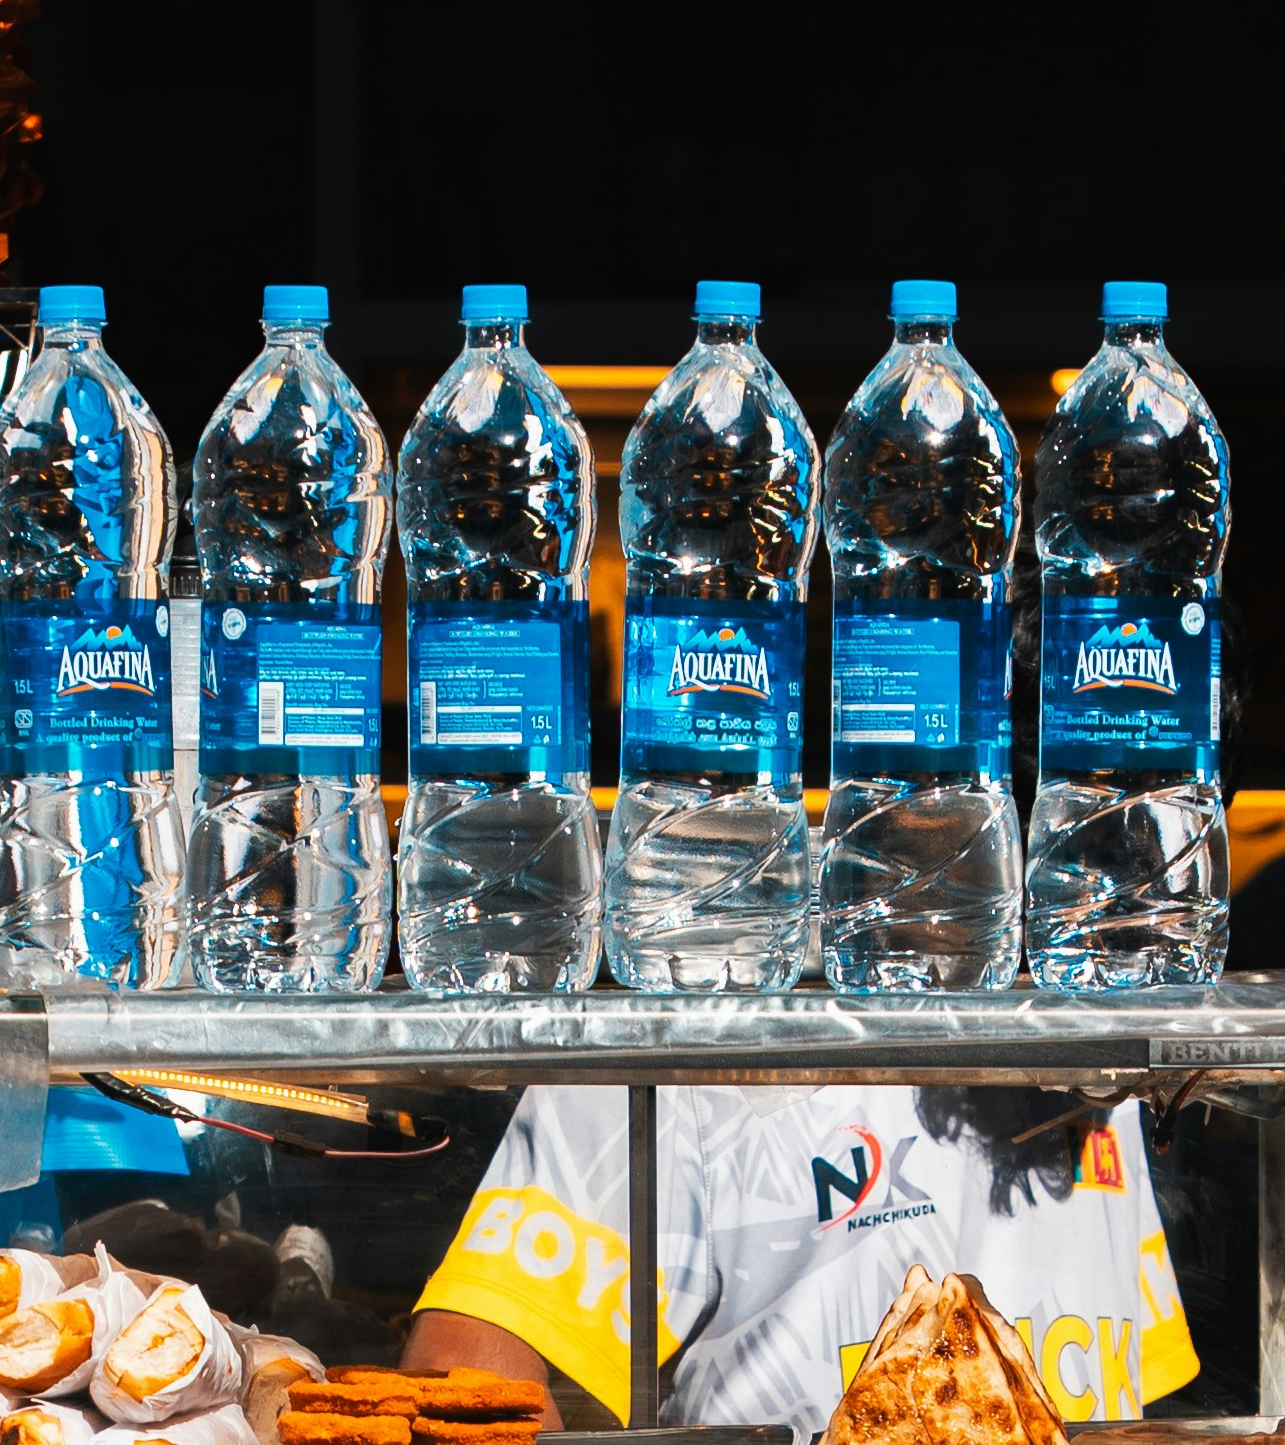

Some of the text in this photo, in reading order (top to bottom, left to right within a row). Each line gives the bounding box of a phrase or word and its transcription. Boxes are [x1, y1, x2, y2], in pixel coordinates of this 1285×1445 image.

[57, 643, 156, 691] AQUAFINA
[667, 645, 771, 697] AQUAFINA
[1073, 641, 1179, 694] AQUAFINA
[50, 716, 89, 729] Bottled
[91, 716, 134, 730] Drinking
[1102, 714, 1148, 727] Drinking
[1151, 714, 1180, 727] Water
[46, 732, 82, 745] quality
[85, 732, 119, 745] product
[848, 1204, 936, 1233] NACHCHIKUDA
